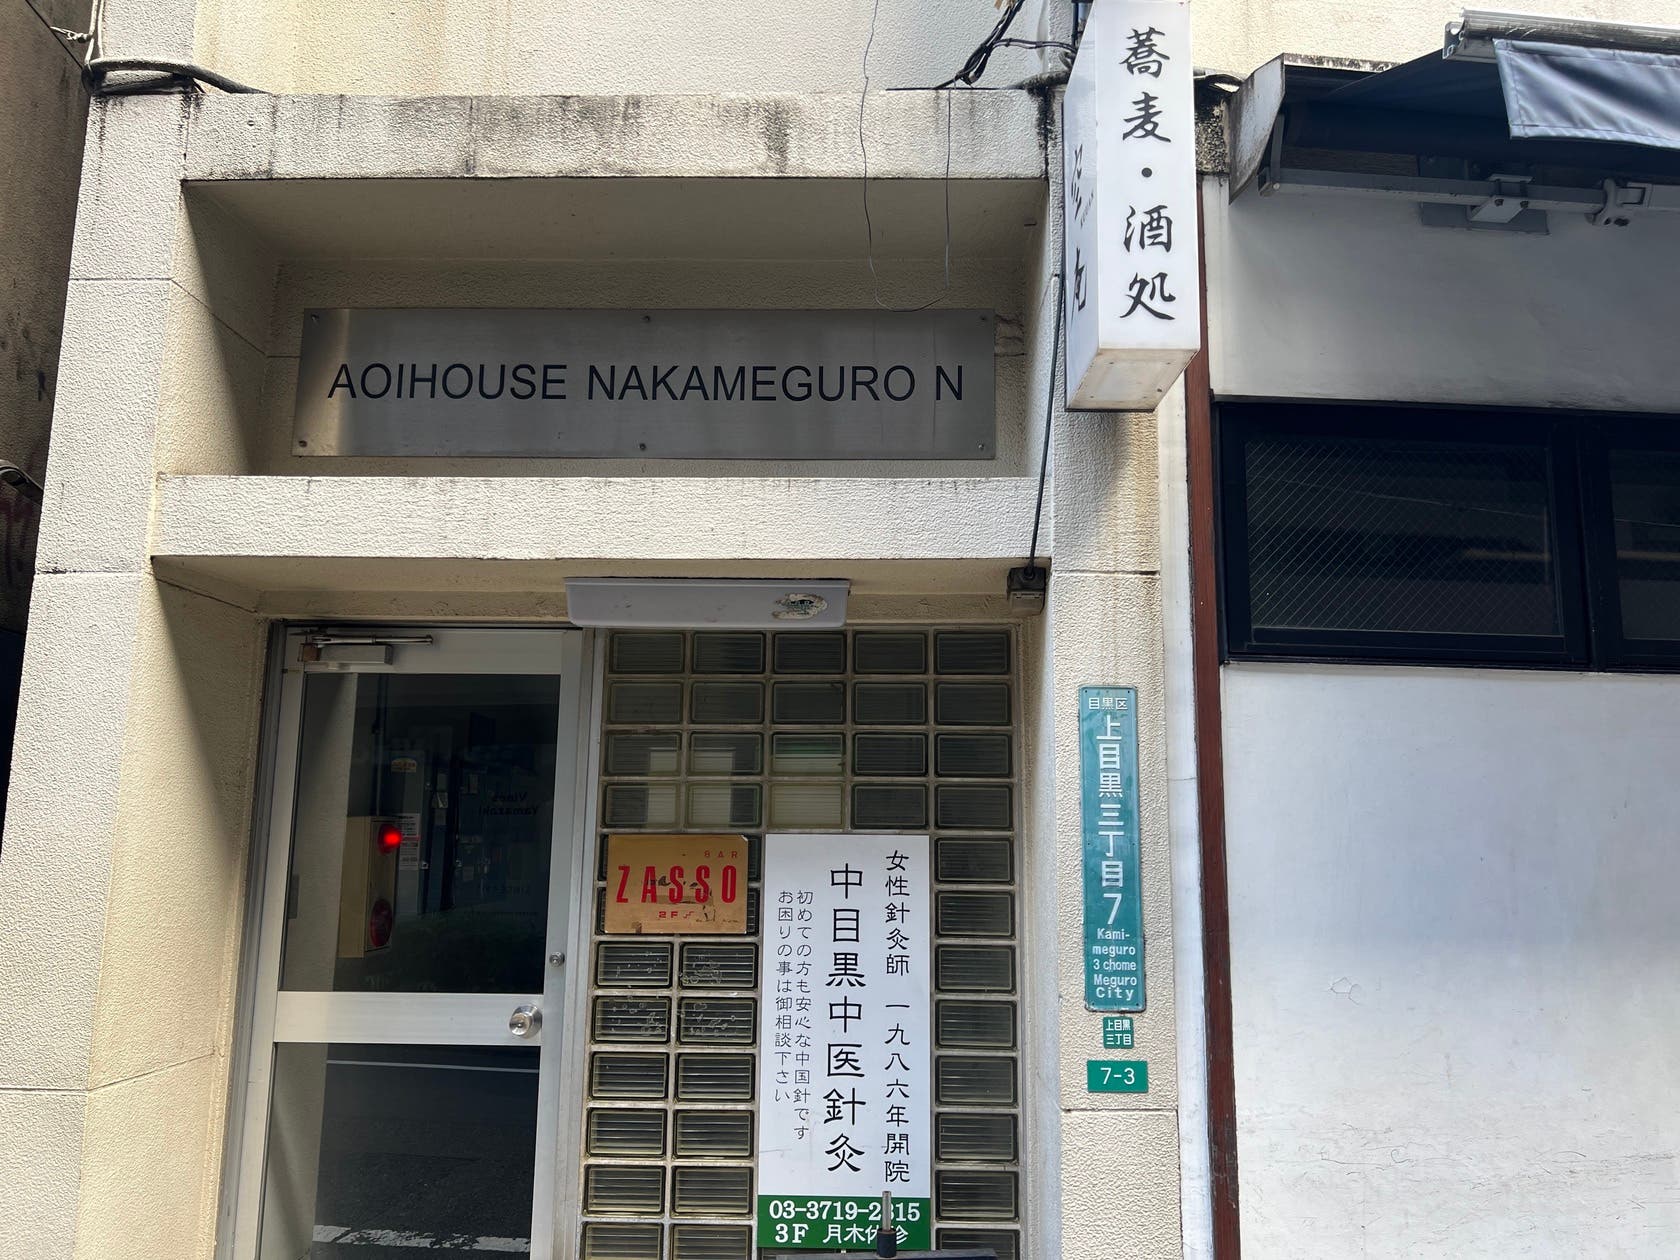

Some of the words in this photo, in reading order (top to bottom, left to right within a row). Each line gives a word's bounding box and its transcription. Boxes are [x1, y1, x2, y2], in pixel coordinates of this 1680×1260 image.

[328, 363, 567, 399] AOIHOUSE
[587, 365, 915, 401] NAKAMEGURO
[936, 365, 962, 400] N
[1089, 697, 1128, 710] 目黒区
[616, 865, 737, 904] ZASSO
[885, 850, 910, 976] 女性針灸師
[1097, 928, 1130, 940] Kami-
[1092, 945, 1136, 957] meguro
[1093, 958, 1100, 970] 3
[1103, 959, 1137, 970] chome
[1094, 974, 1137, 987] Meguro
[774, 890, 794, 1102] お困りの事は御相談下さい
[1096, 987, 1134, 1000] City
[793, 890, 814, 1140] 初めての方も安心な中国針です
[823, 863, 866, 1173] 中目黒中医針灸
[1106, 1019, 1131, 1031] 上目黒
[1106, 1034, 1131, 1045] 三丁目
[1101, 1067, 1135, 1084] 7-3
[884, 1005, 911, 1182] 一九八六年開院
[775, 1223, 809, 1243] 3F
